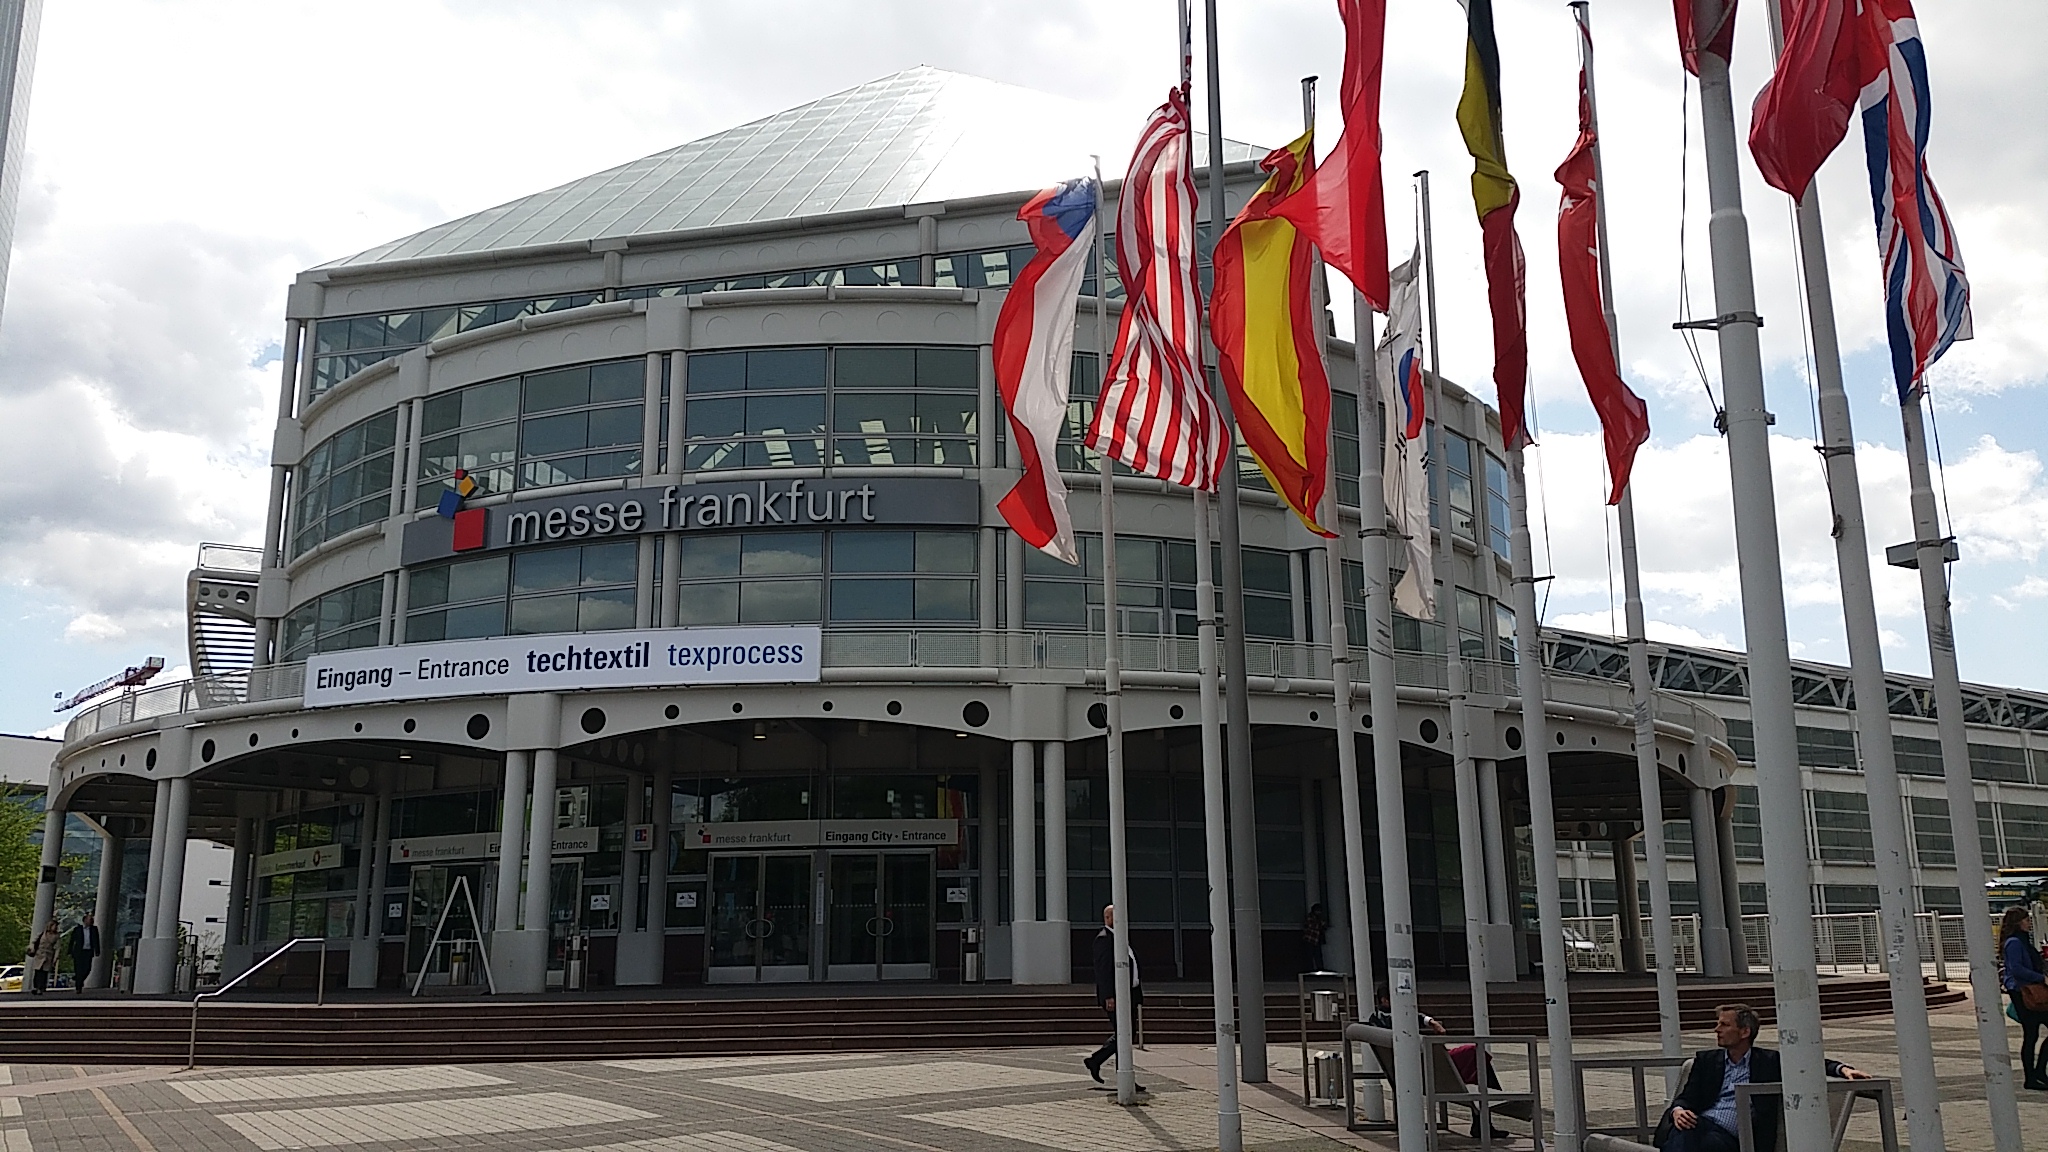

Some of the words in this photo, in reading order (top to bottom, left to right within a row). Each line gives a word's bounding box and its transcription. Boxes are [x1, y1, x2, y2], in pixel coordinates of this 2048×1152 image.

[506, 500, 644, 544] messe
[659, 480, 876, 529] frankfurt
[316, 667, 393, 692] Eingang
[417, 658, 510, 680] Entrance
[526, 641, 650, 673] techtextil
[667, 643, 803, 672] texprocess
[715, 835, 746, 844] messe
[749, 832, 791, 843] frankfurt
[825, 831, 869, 843] Eingang
[871, 830, 893, 843] City
[902, 830, 947, 841] Entrance
[552, 840, 588, 850] Entrance
